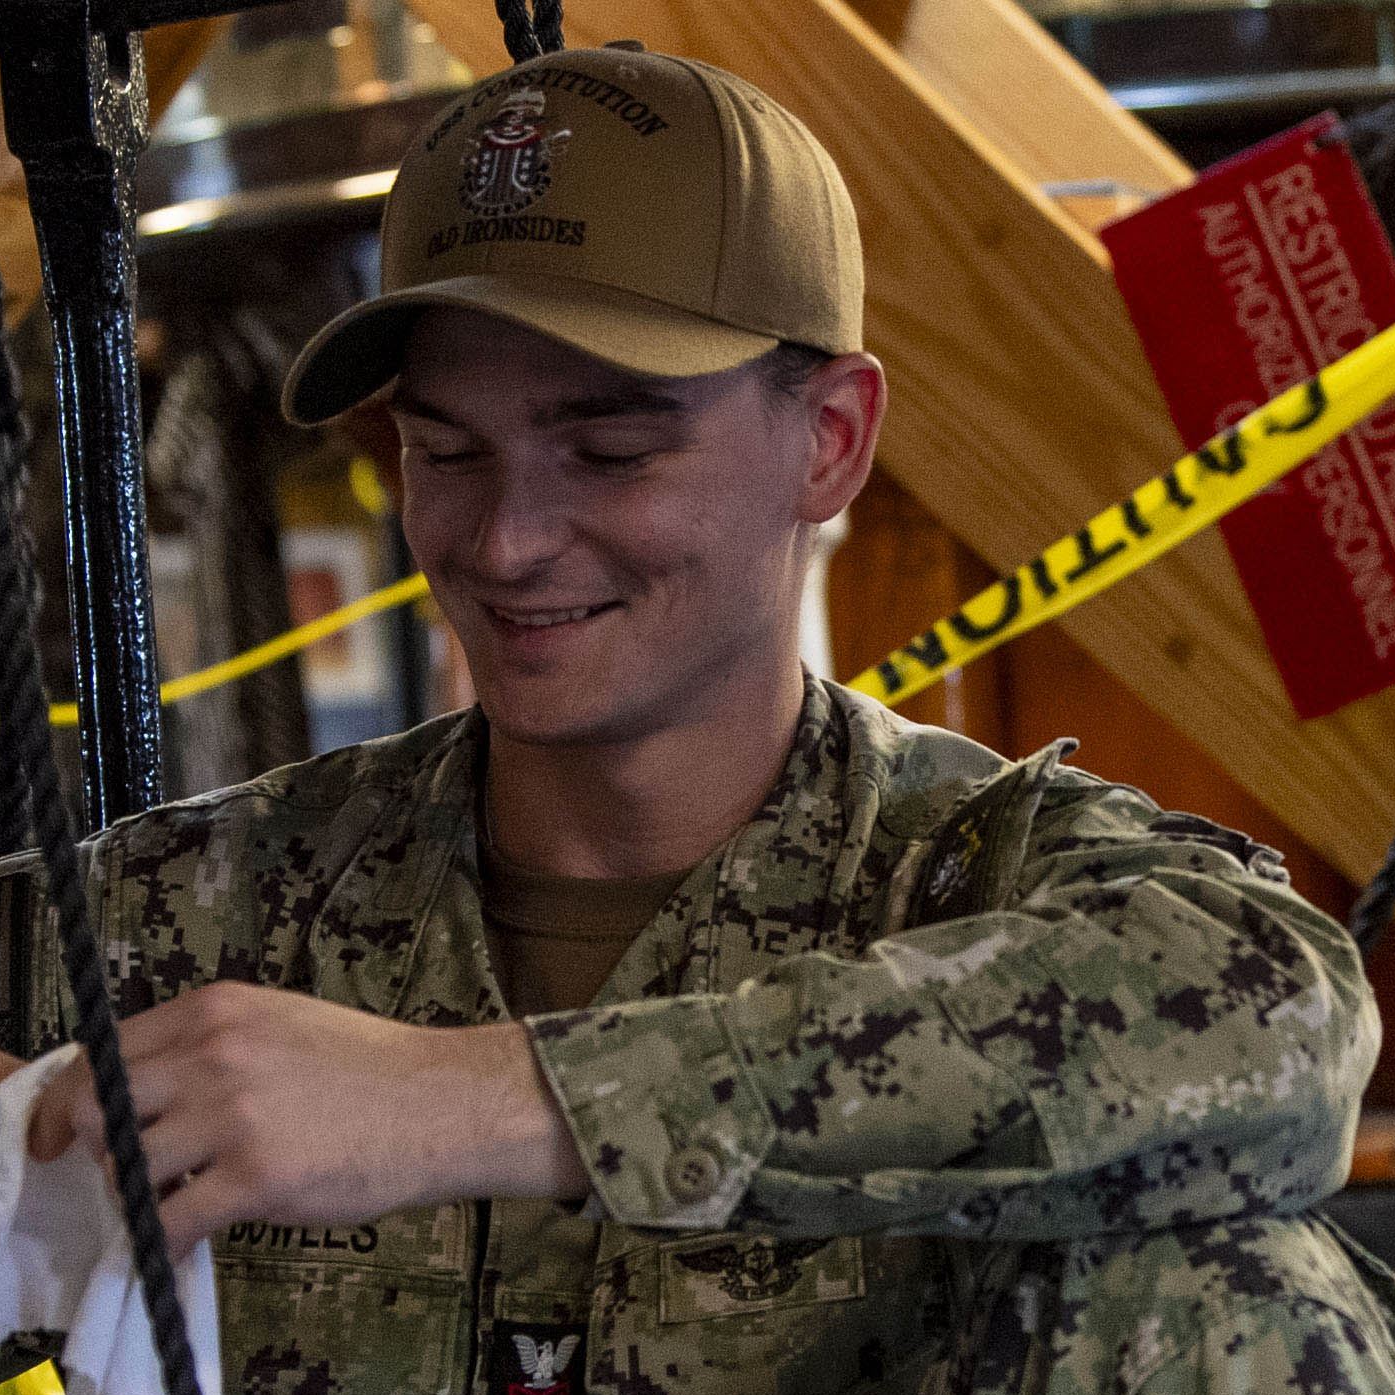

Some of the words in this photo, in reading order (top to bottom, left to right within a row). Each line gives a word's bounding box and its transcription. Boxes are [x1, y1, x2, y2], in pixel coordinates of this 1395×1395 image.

[471, 67, 670, 137] CONSTITUTION
[427, 226, 459, 259] OLD
[461, 215, 586, 246] IRONSIDES
[1197, 200, 1317, 402] AUTHORIZ
